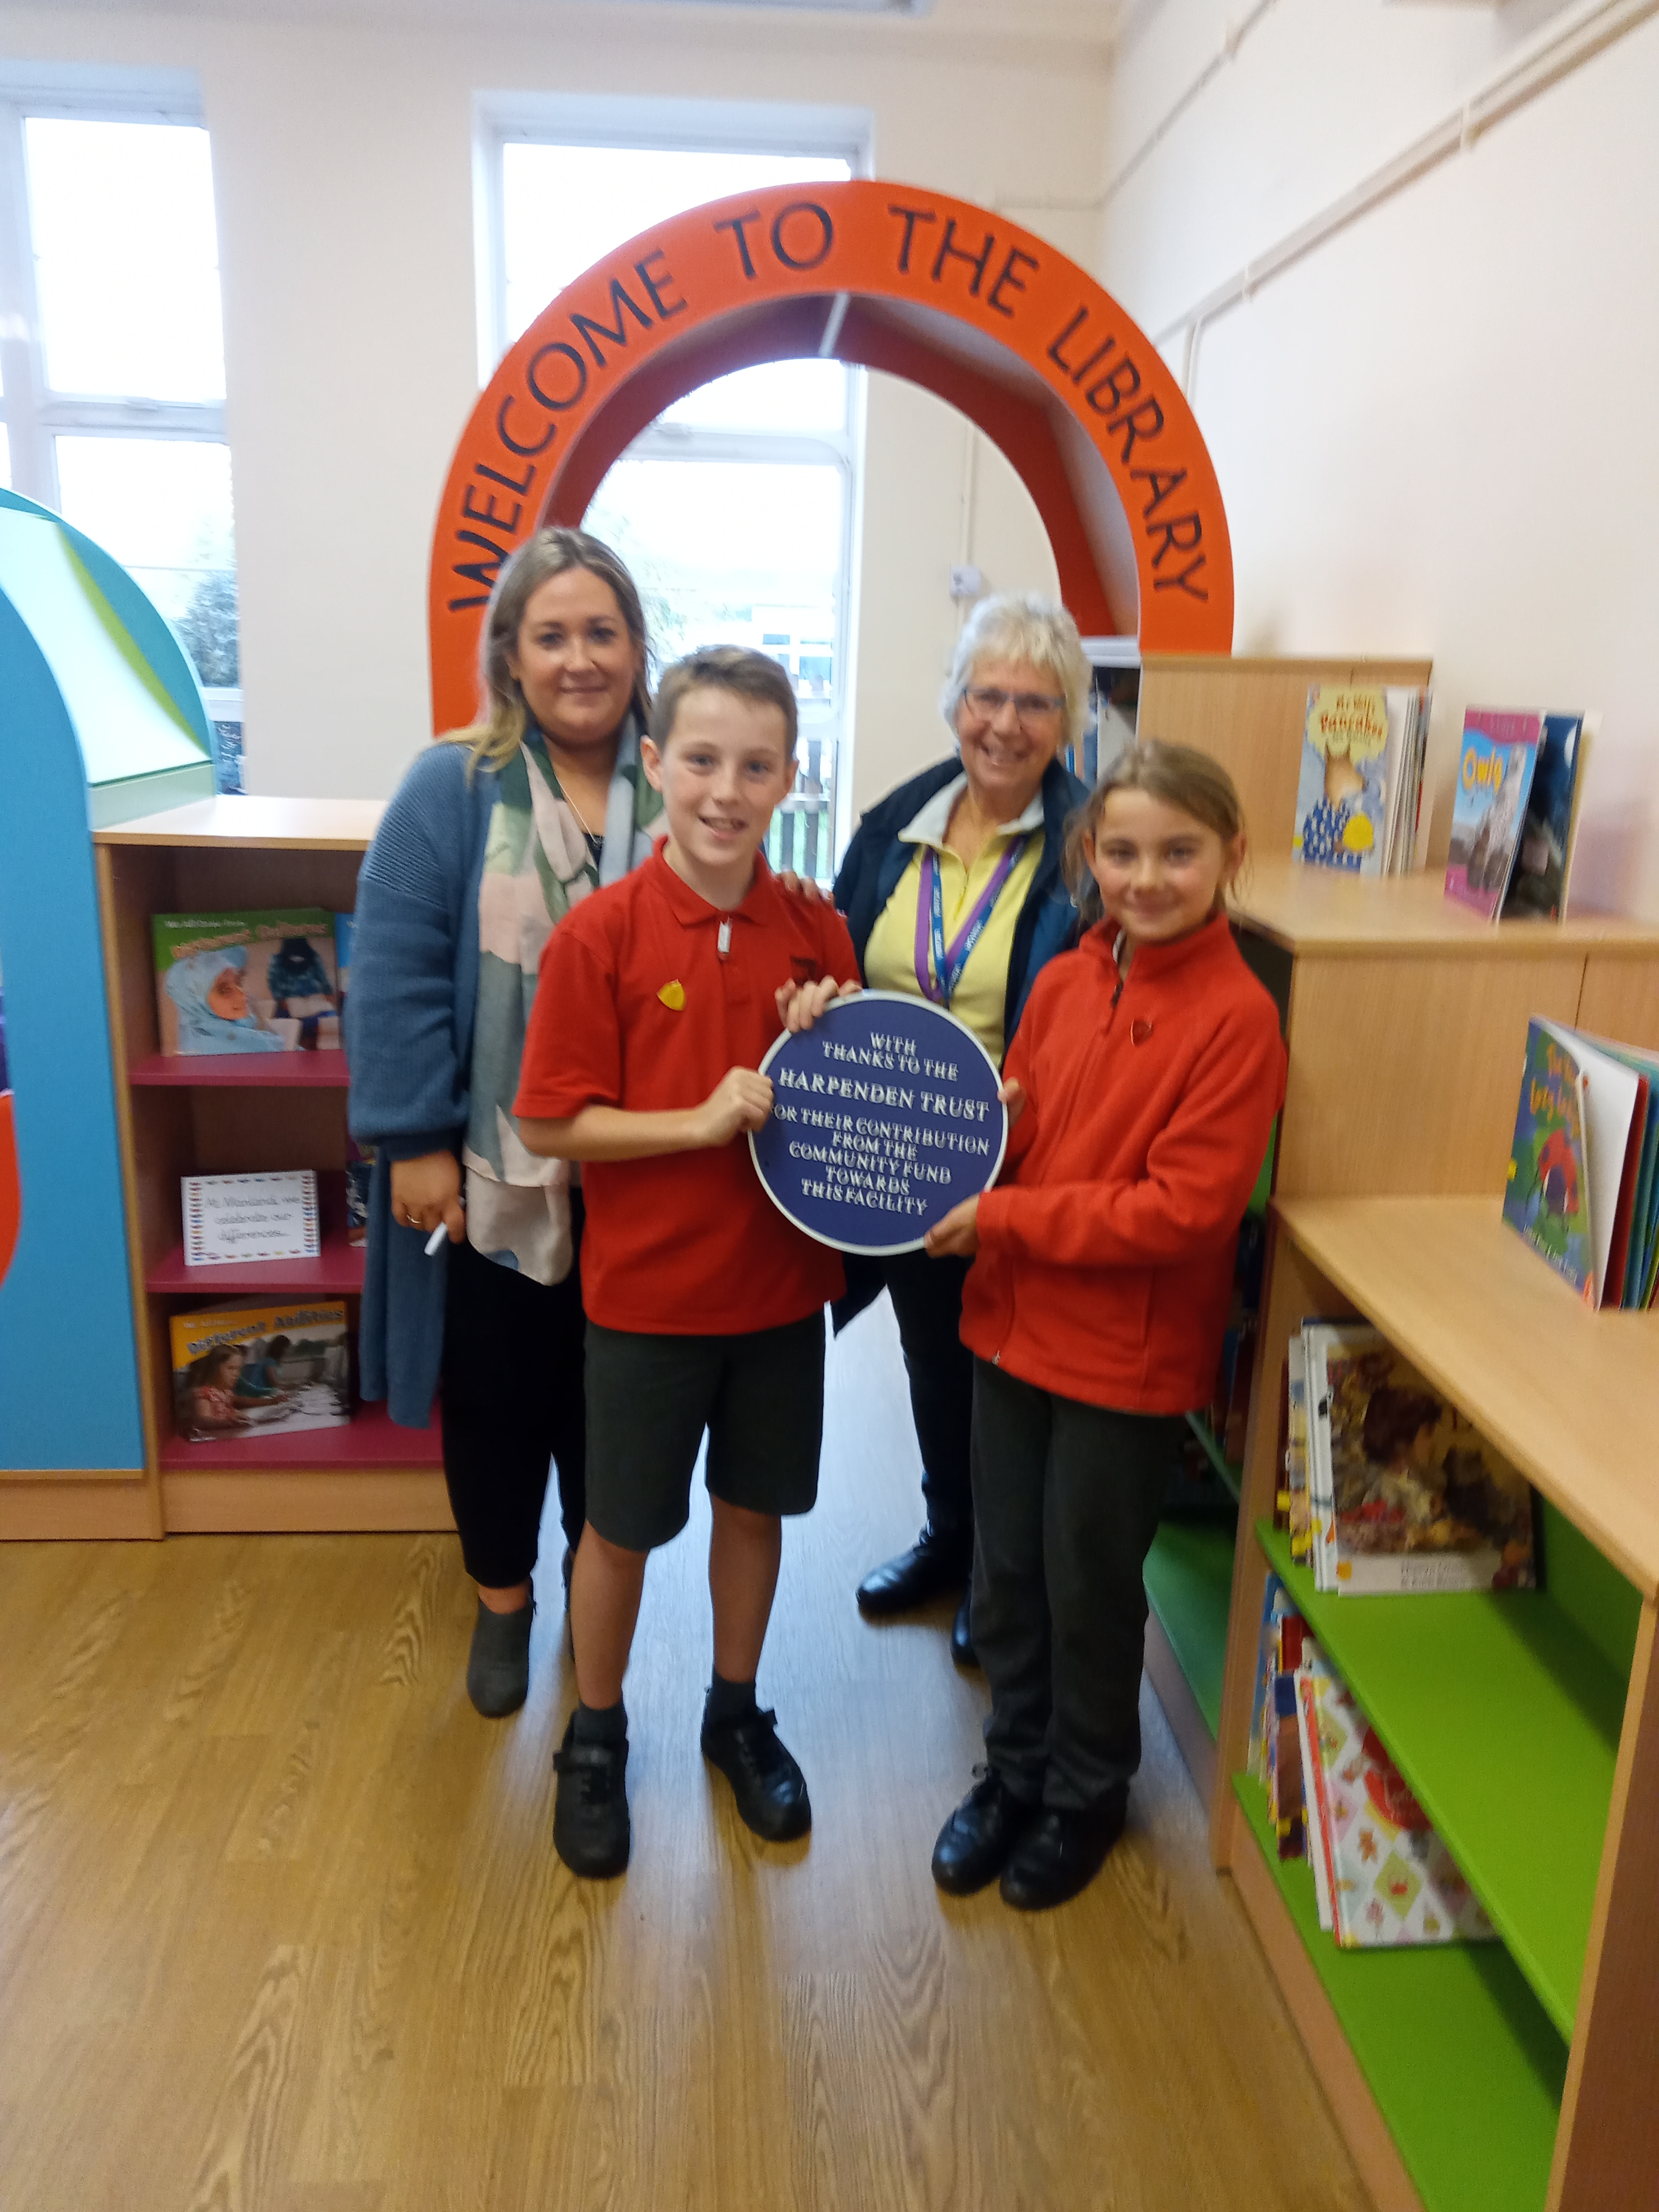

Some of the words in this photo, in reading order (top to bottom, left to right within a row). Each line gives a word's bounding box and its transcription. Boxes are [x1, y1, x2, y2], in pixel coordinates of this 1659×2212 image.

[448, 248, 688, 611] WELCOME
[714, 202, 833, 280] TO
[887, 204, 1040, 319] THE
[1046, 304, 1209, 602] LIBRARY
[822, 1040, 894, 1070] THANKS
[898, 1054, 920, 1075] TO
[924, 1058, 959, 1082] THE
[870, 1032, 917, 1056] WITH
[778, 1067, 916, 1109] HARPENDEN
[920, 1091, 990, 1122] TRUST
[772, 1103, 798, 1123] OR
[801, 1107, 853, 1133] THEIR
[856, 1117, 990, 1156] CONTRIBUTION
[832, 1130, 881, 1155] FROM
[884, 1139, 918, 1161] THE
[789, 1141, 901, 1176] COMMUNITY
[902, 1161, 952, 1185] FUND
[826, 1164, 911, 1196] TOWARDS
[801, 1178, 843, 1202] THIS
[844, 1186, 928, 1216] FACILITY
